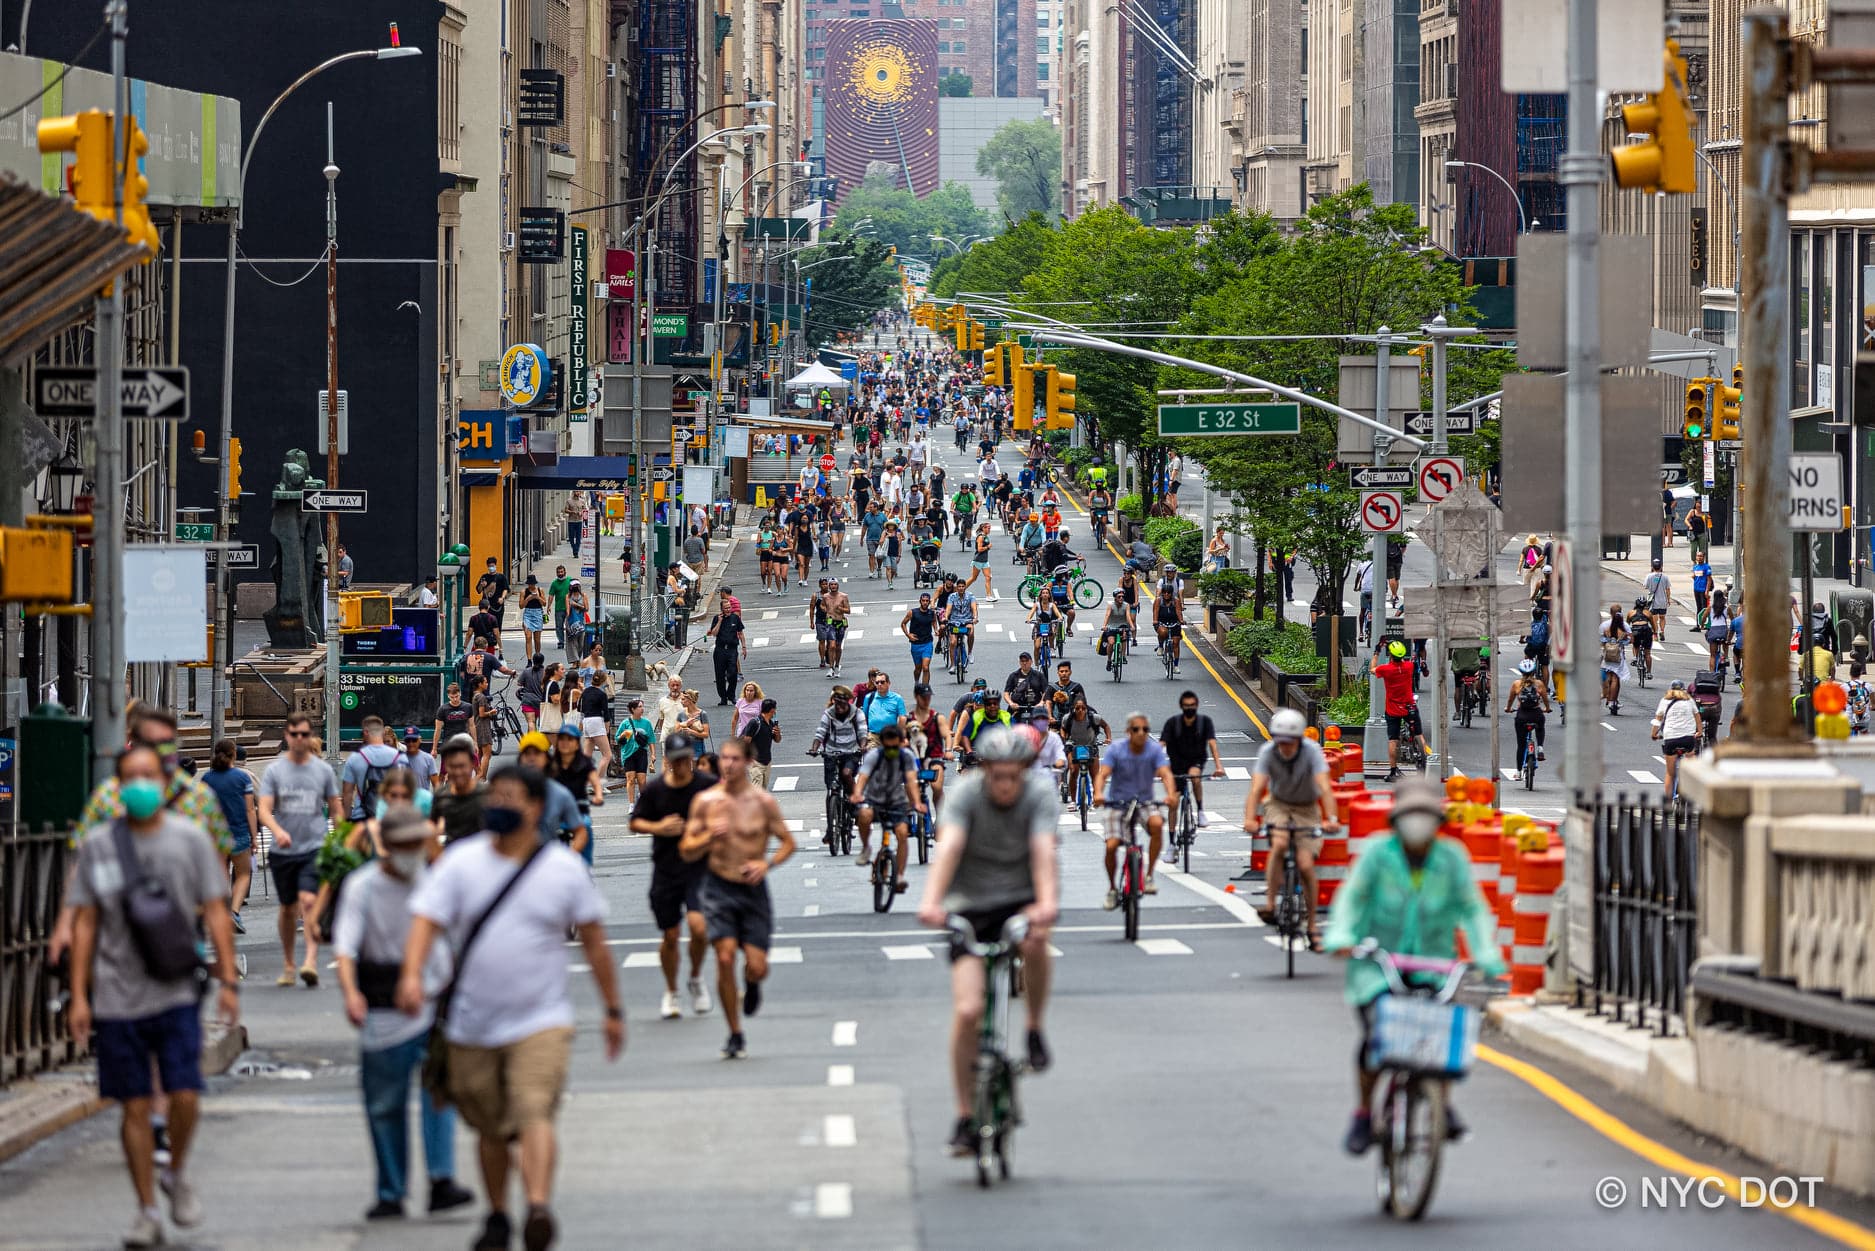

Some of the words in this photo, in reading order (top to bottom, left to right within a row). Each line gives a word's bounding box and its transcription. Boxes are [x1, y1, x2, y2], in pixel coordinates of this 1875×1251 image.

[573, 232, 585, 296] FIRST
[614, 305, 626, 351] THAI
[653, 318, 685, 326] MOND'S
[572, 305, 586, 405] REPUBLIC
[47, 383, 92, 401] ONE
[122, 384, 166, 402] WAY
[1198, 411, 1208, 428] E
[1215, 410, 1236, 428] 32
[1243, 410, 1260, 428] St
[1414, 420, 1433, 429] ONE
[1360, 473, 1379, 482] ONE
[1386, 473, 1406, 481] WAY
[1788, 467, 1819, 488] NO
[312, 496, 331, 505] ONE
[338, 496, 359, 505] WAY
[1789, 498, 1838, 518] URNS
[184, 526, 199, 539] 32
[206, 551, 217, 561] NE
[228, 551, 249, 561] WAY
[340, 675, 354, 684] 33
[356, 675, 385, 685] Street
[388, 675, 422, 685] Station
[345, 695, 354, 706] 6
